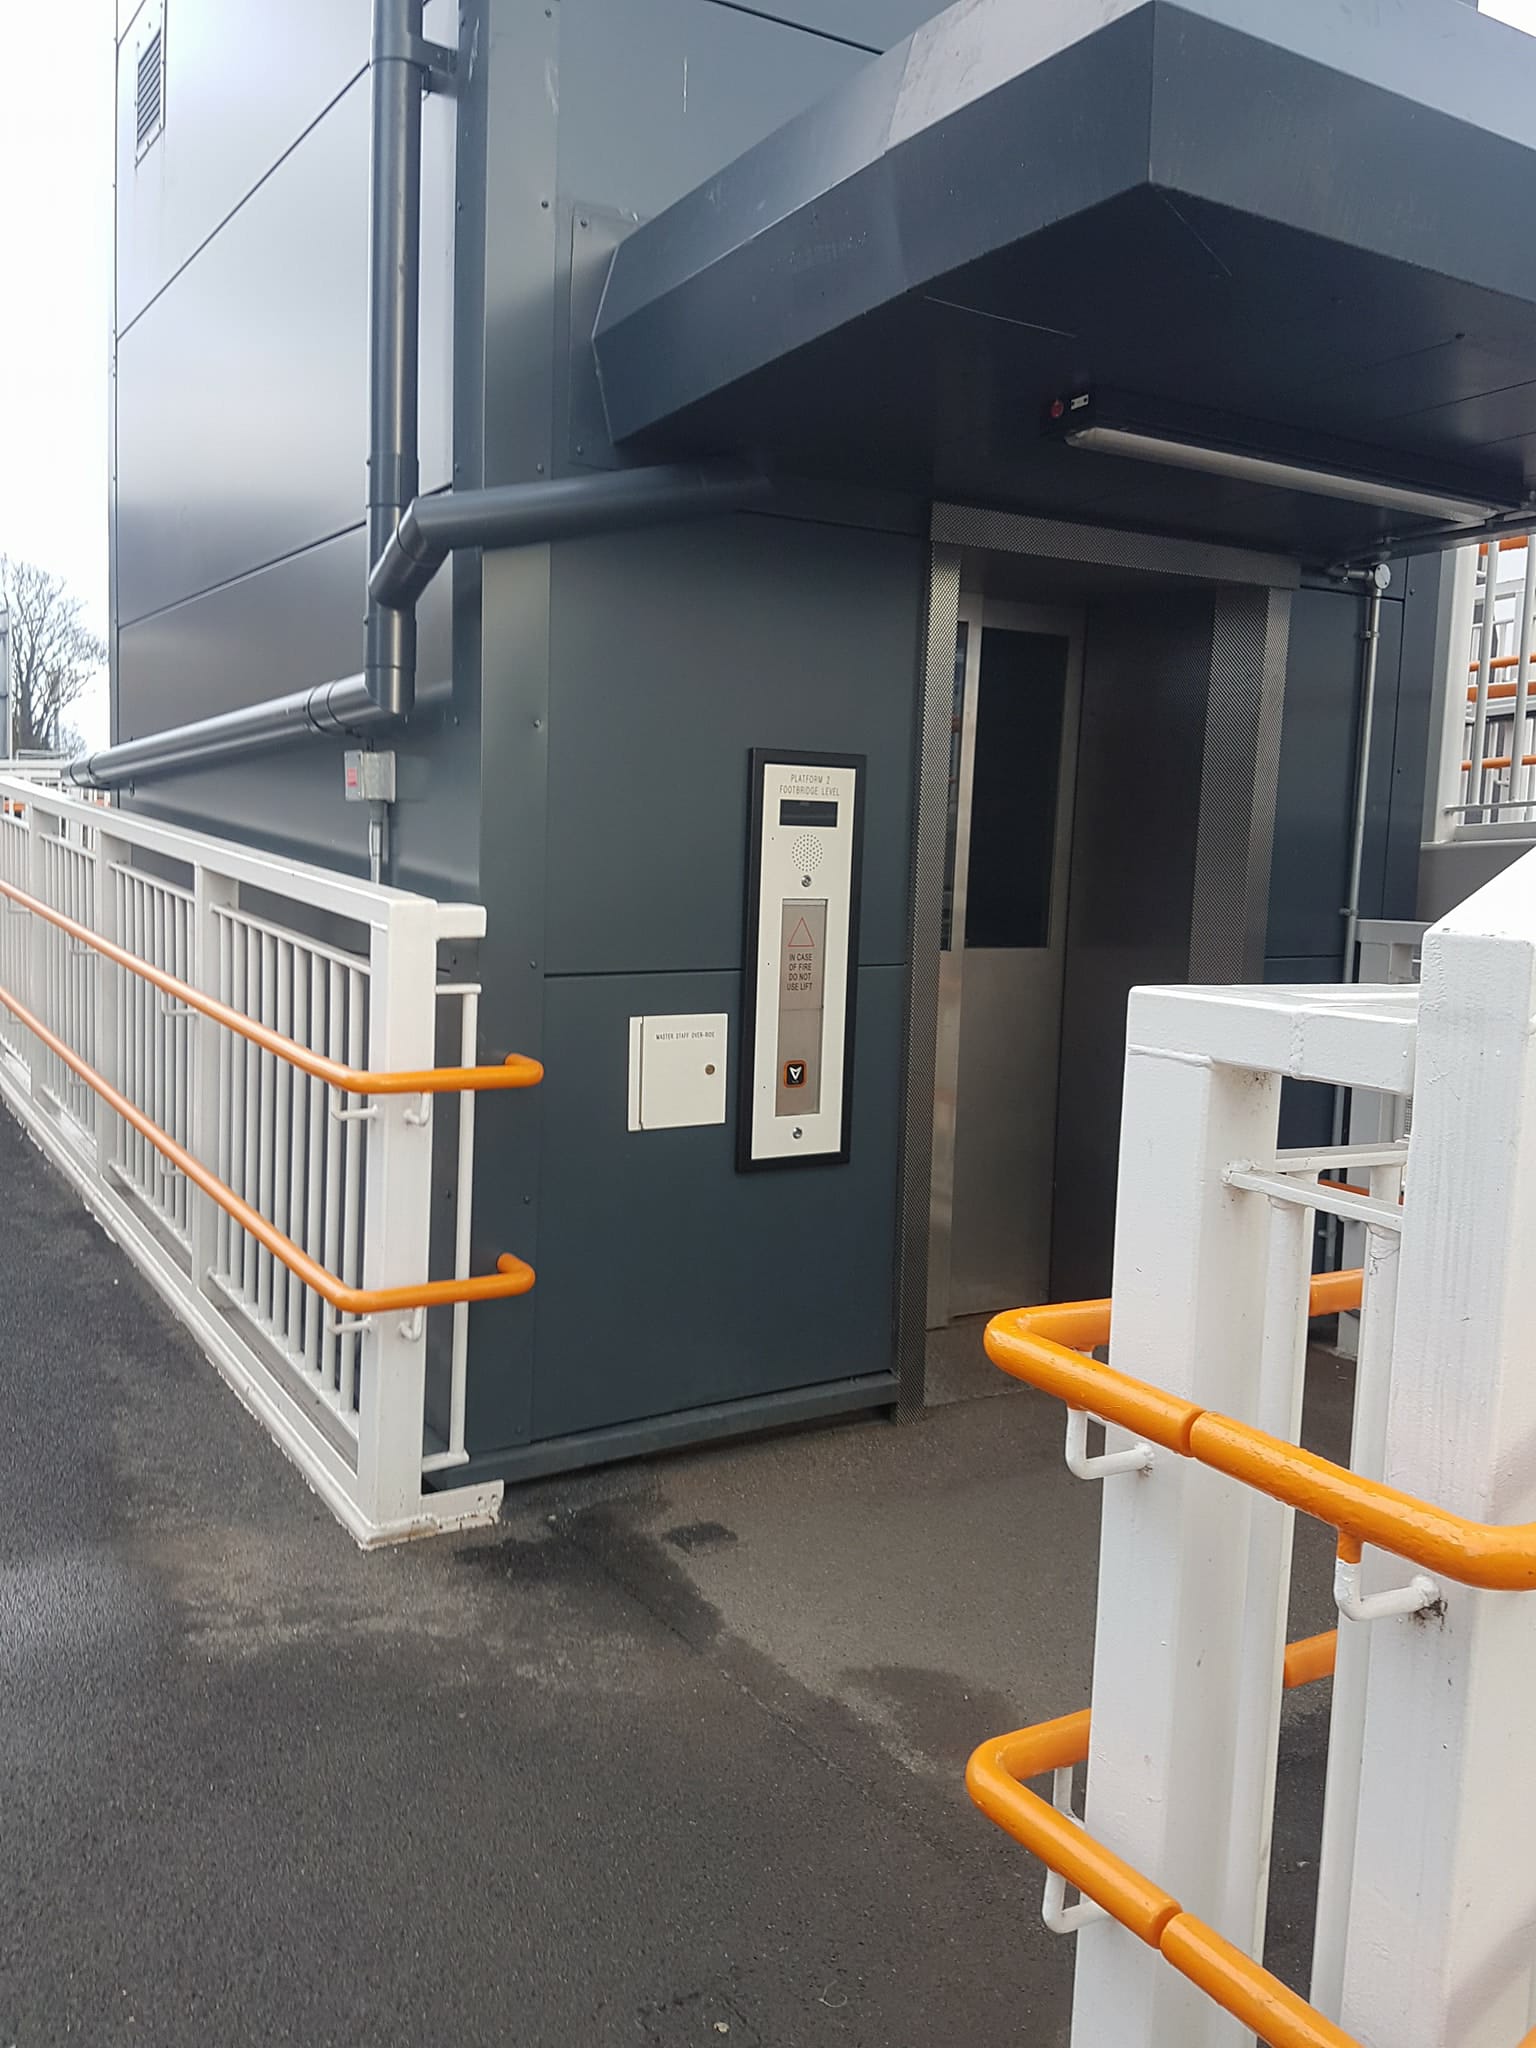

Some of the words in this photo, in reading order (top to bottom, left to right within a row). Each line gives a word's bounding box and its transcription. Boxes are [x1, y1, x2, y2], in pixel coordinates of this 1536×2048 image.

[791, 774, 823, 784] PLATFORM
[779, 784, 818, 796] FOOTBRIDGE
[821, 787, 840, 797] LEVEL
[789, 953, 796, 961] IN
[797, 953, 812, 961] CASE
[788, 963, 797, 971] OF
[799, 963, 812, 971] FIRE
[788, 973, 798, 981] DO
[799, 973, 811, 981] NOT
[787, 982, 799, 991] USE
[800, 982, 812, 990] LIFT
